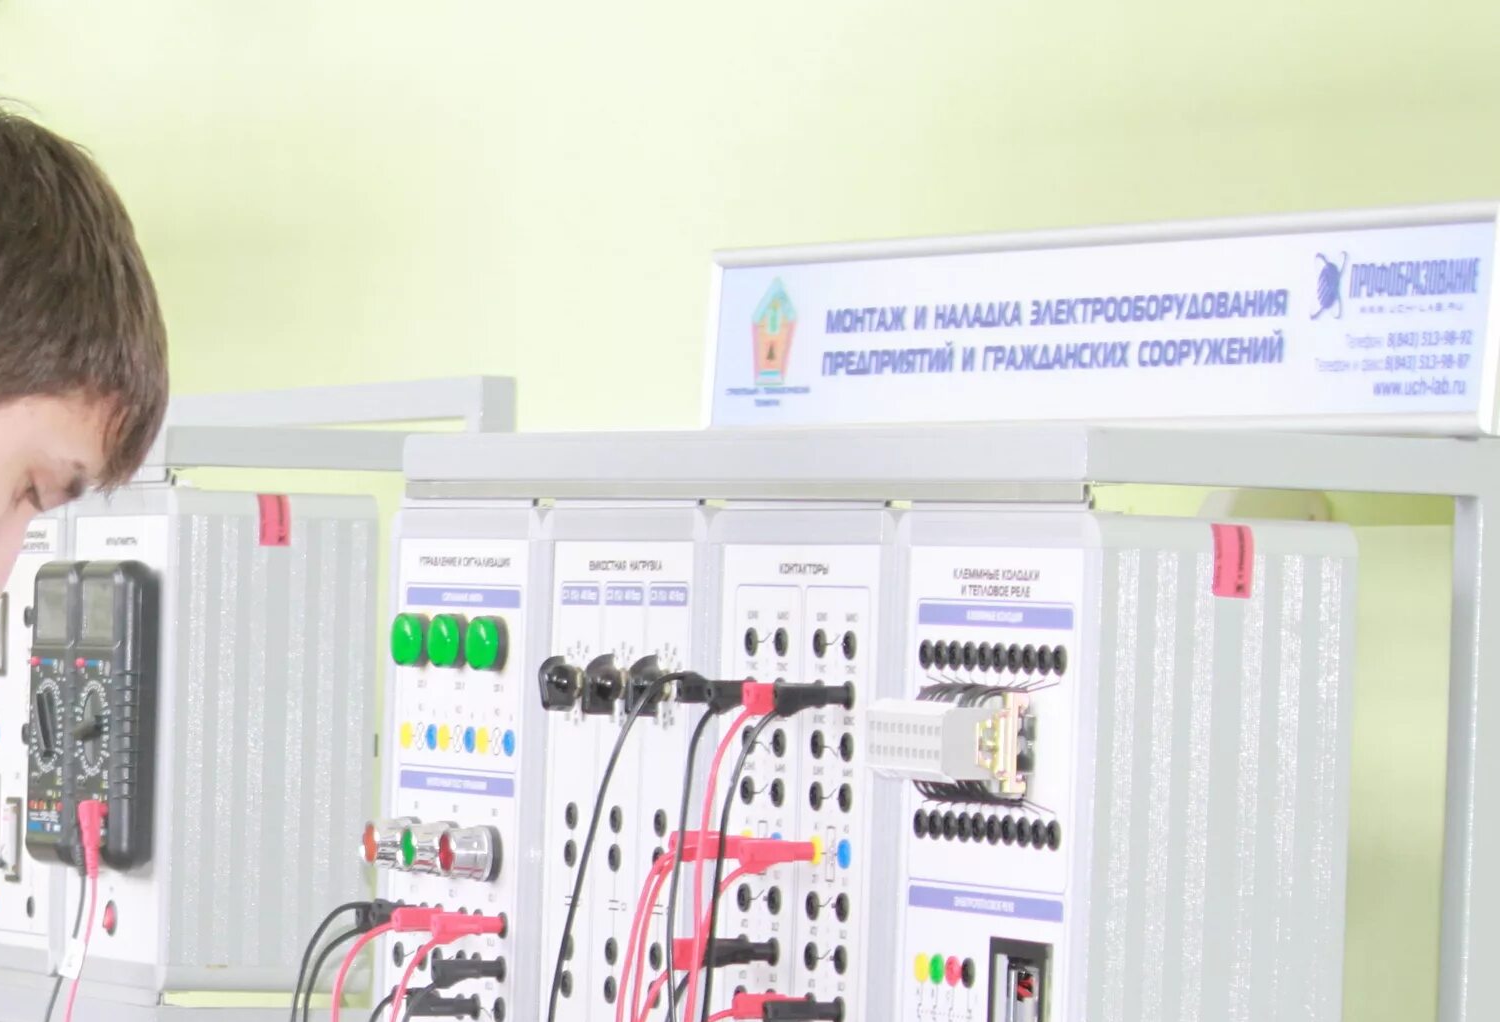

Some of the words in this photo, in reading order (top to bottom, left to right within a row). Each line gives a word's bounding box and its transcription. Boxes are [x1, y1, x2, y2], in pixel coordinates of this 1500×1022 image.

[1349, 256, 1481, 299] ПРОФОБРАЗОВАНИЕ
[825, 304, 908, 334] МОНТАЖ
[913, 303, 929, 331] И
[933, 299, 1023, 330] НАЛАДКА
[1029, 288, 1290, 327] ЭЛЕКТРООБОРУДОВАНИЯ
[821, 339, 956, 377] ПРЕДПРИЯТИЙ
[961, 346, 976, 372] И
[981, 340, 1132, 373] ГРАЖДАНСКИХ
[1137, 328, 1286, 368] СООРУЖЕНИЙ
[1372, 376, 1468, 396] www.uch-lab.ru
[629, 559, 663, 572] НАГРУЗКА
[779, 562, 830, 576] КОНТАКТОРЫ
[953, 567, 1000, 581] КЛЕММНЫЕ
[1001, 569, 1041, 582] КОЛОДКИ
[968, 584, 1010, 597] ТЕПЛОВОЕ
[1010, 586, 1032, 598] РЕЛЕ
